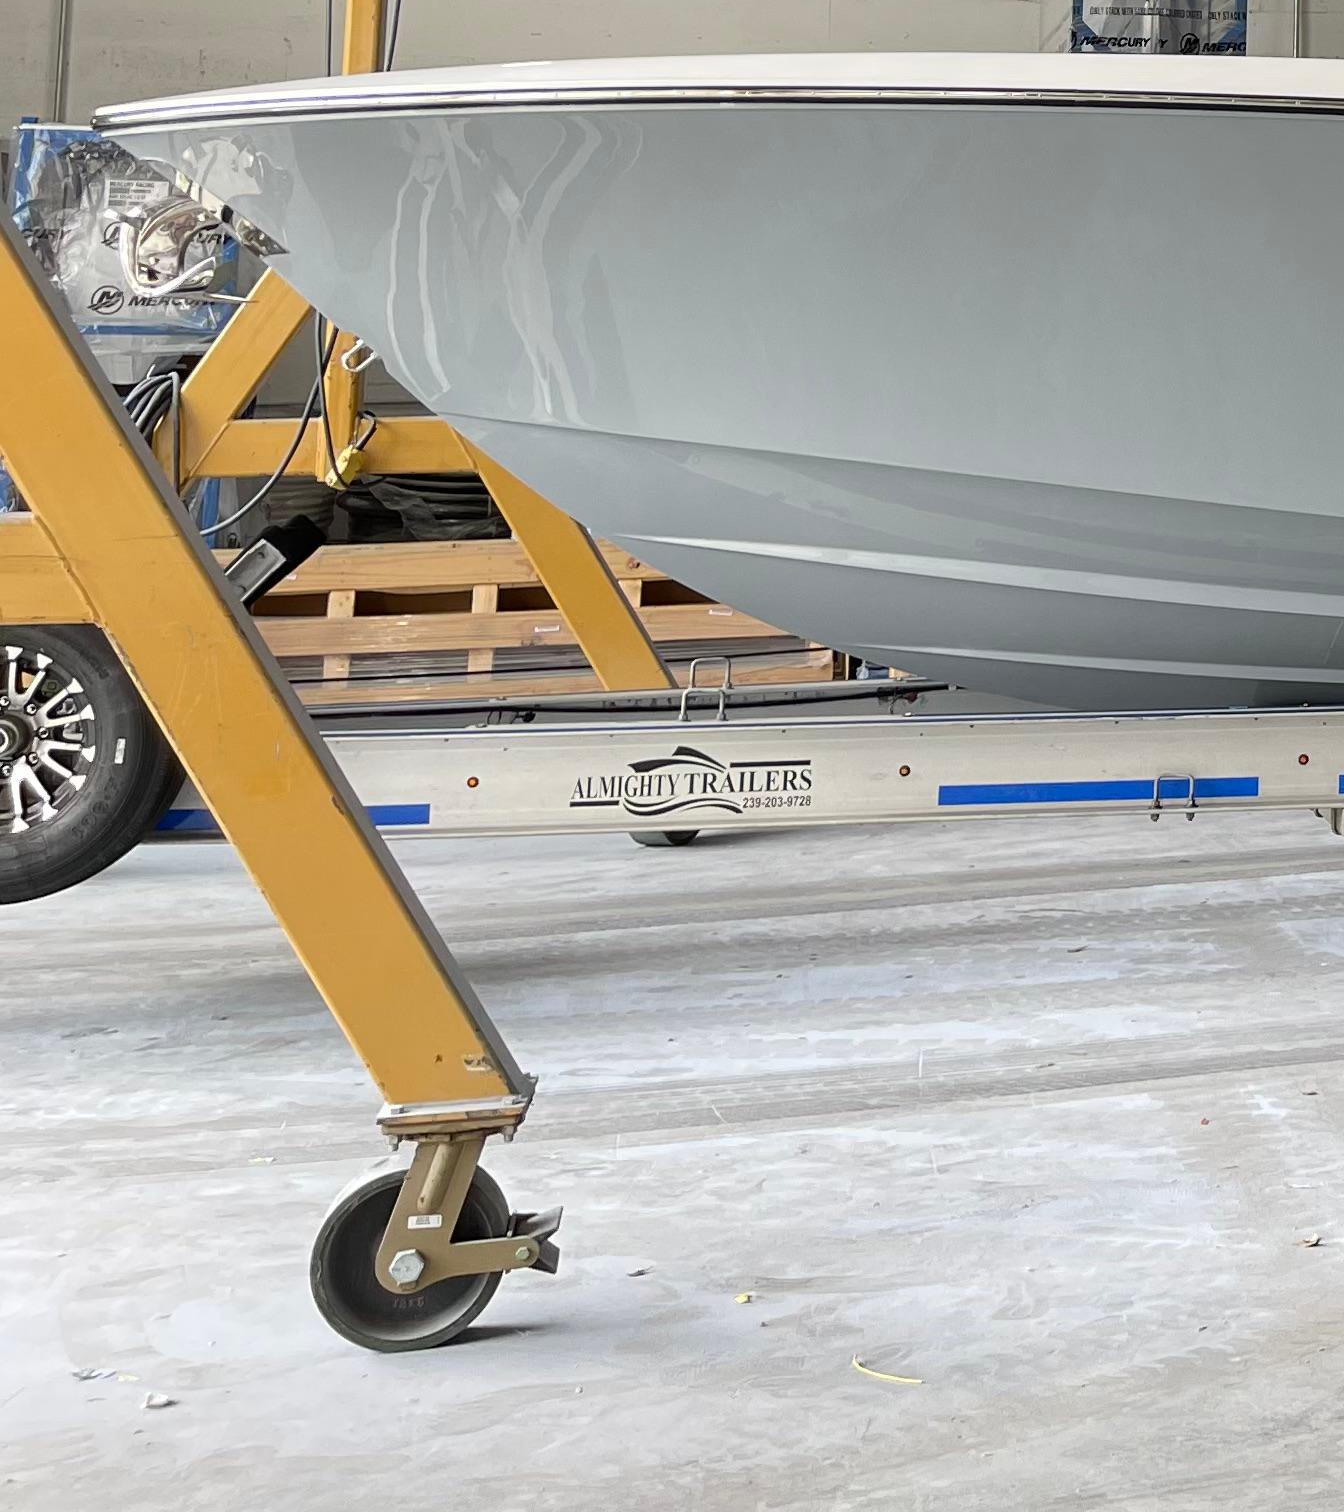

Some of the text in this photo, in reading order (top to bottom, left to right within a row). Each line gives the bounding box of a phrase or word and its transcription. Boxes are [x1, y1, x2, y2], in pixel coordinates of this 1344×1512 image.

[571, 769, 812, 800] ALMIGHTY TRAILERS
[742, 795, 812, 809] 239-203-9728
